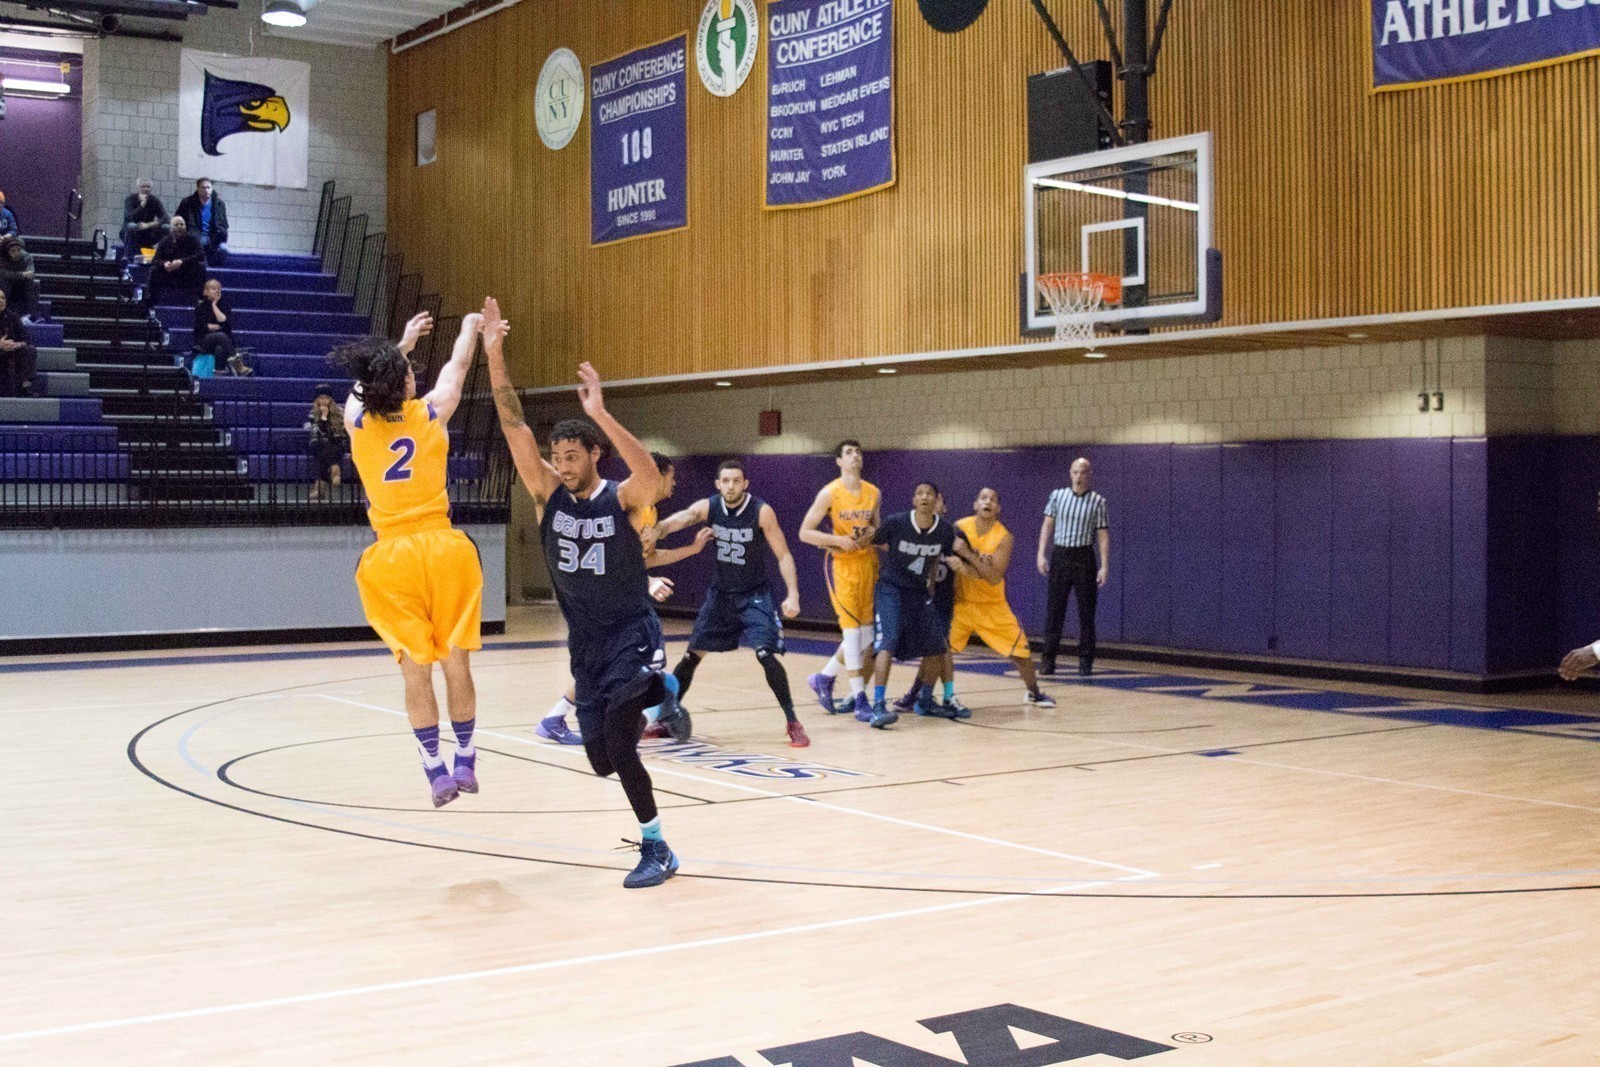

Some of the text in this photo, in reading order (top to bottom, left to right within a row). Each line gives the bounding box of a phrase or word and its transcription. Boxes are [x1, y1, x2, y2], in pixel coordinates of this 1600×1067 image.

[770, 0, 887, 36] CUNY ATHLE
[777, 13, 882, 64] CONFERENCE
[592, 49, 685, 95] CUNY CONFERENCE
[820, 65, 857, 87] LEHMAN
[599, 82, 676, 121] CHAMPIONSHIPS
[820, 76, 890, 111] MEDGAR EVERS
[770, 101, 817, 117] BROOKLYN
[771, 127, 793, 139] CCNY
[821, 110, 864, 134] NYC TECH
[621, 127, 653, 165] 109
[820, 126, 889, 158] STATEN ISLAND
[770, 148, 804, 162] HUNTER
[770, 171, 811, 184] JOHN JAY
[821, 165, 847, 180] YORK
[608, 178, 667, 212] HUNTER
[616, 212, 639, 227] SINCE
[382, 437, 416, 482] 2
[838, 510, 871, 521] HUNTE
[558, 538, 606, 575] 34
[716, 540, 746, 565] 22
[908, 556, 925, 575] 4
